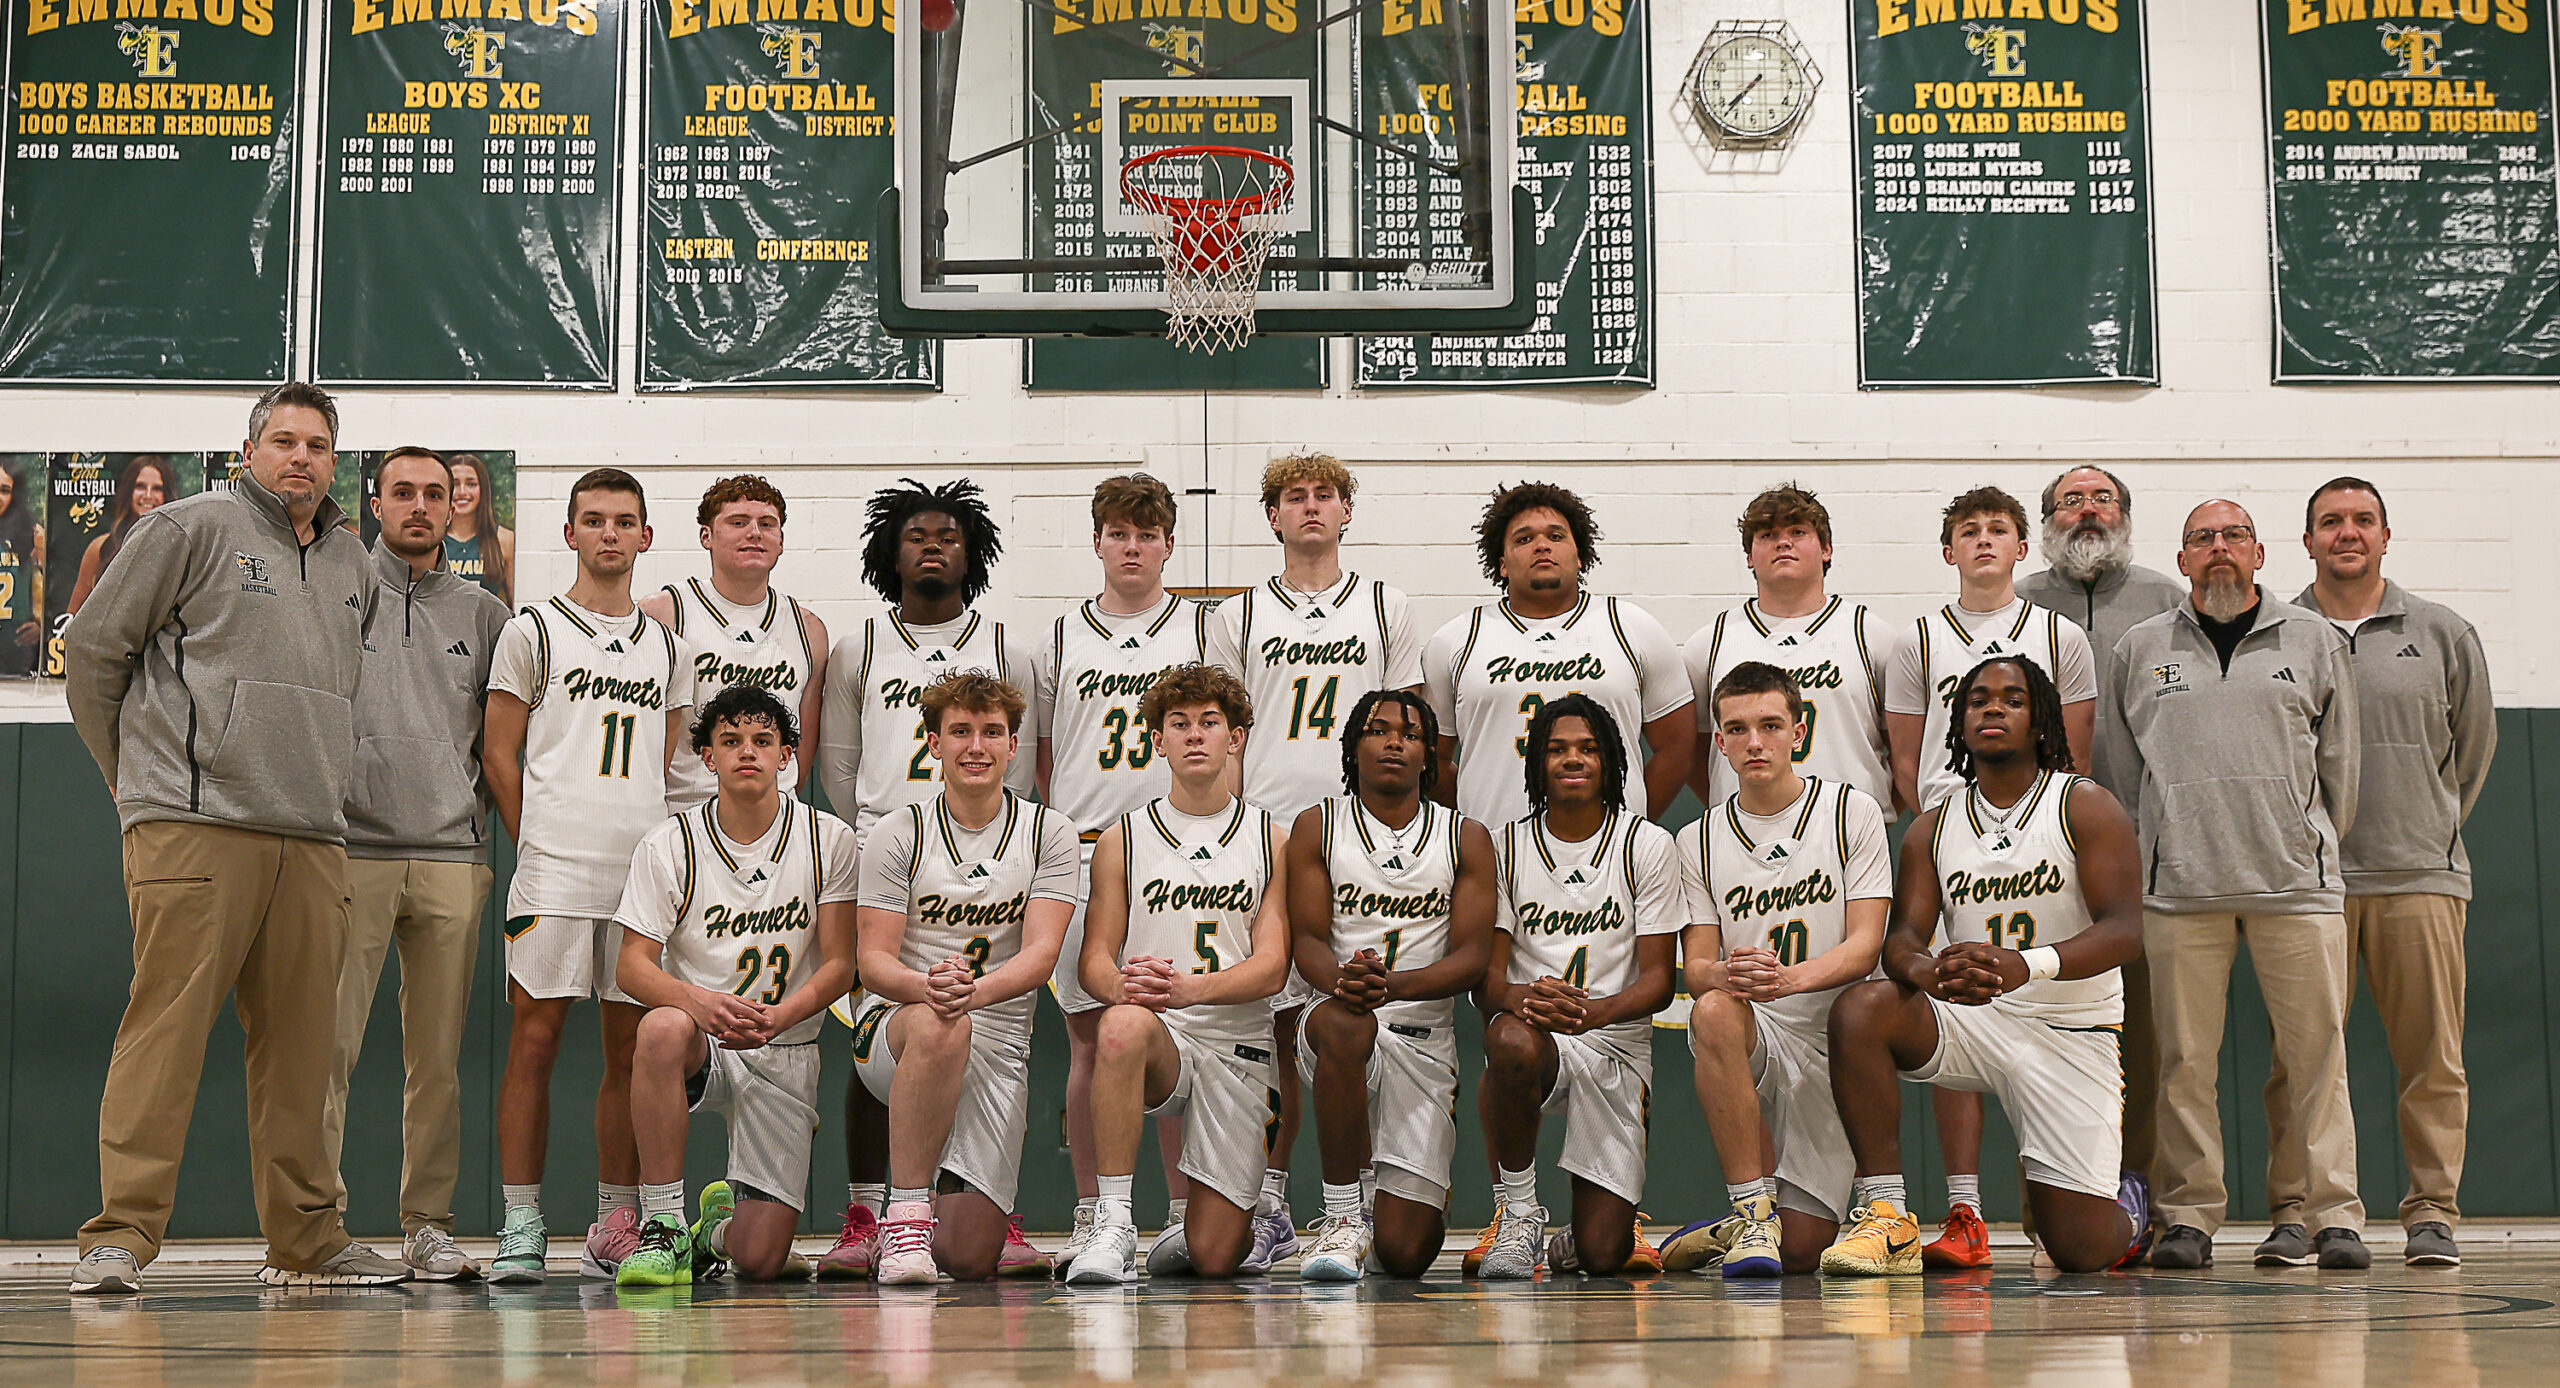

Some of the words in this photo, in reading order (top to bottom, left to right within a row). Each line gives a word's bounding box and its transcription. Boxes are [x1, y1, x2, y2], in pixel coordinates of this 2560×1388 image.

[19, 82, 88, 109] BOYS
[97, 83, 273, 110] BASKETBALL
[404, 82, 488, 108] BOYS
[499, 82, 541, 109] XC
[705, 84, 875, 111] FOOTBALL
[1914, 81, 2083, 109] FOOTBALL
[2326, 80, 2496, 107] FOOTBALL
[19, 114, 68, 135] 1000
[75, 115, 156, 135] CAREER
[163, 115, 272, 136] REBOUNDS
[366, 113, 431, 134] LEAGUE
[489, 114, 567, 135] DISTRICT
[572, 115, 589, 135] XI
[684, 116, 749, 136] LEAGUE
[805, 116, 884, 137] DISTRICT
[1128, 113, 1204, 133] POINT
[1213, 113, 1278, 133] CLUB
[1379, 113, 1440, 135] 1000
[1521, 115, 1627, 136] PASSING
[1875, 113, 1938, 134] 1000
[1945, 112, 2010, 133] YARD
[2017, 111, 2126, 133] RUSHING
[2284, 109, 2350, 131] 2000
[2357, 110, 2422, 131] YARD
[2429, 111, 2537, 132] RUSHING
[17, 144, 59, 159] 2019
[72, 144, 118, 160] ZACH
[124, 144, 180, 160] SABOL
[231, 145, 272, 160] 1046
[341, 138, 374, 153] 1979
[483, 139, 515, 154] 1976
[524, 139, 556, 154] 1979
[657, 146, 688, 161] 1962
[697, 146, 729, 161] 1963
[1054, 144, 1091, 160] 1941
[1588, 145, 1631, 160] 1532
[1873, 145, 1913, 160] 2017
[2087, 142, 2121, 156] 1111
[2285, 145, 2325, 160] 2014
[2333, 145, 2394, 160] ANDREW
[422, 158, 455, 173] 1999
[523, 159, 555, 174] 1994
[564, 159, 596, 174] 1997
[657, 165, 688, 181] 1972
[697, 165, 728, 180] 1981
[738, 165, 772, 180] 2016
[1054, 164, 1091, 179] 1971
[1376, 162, 1415, 177] 1991
[1588, 162, 1631, 177] 1495
[1874, 162, 1916, 177] 2018
[1985, 161, 2043, 176] MYERS
[2286, 165, 2326, 180] 2015
[2333, 165, 2372, 180] KYLE
[340, 177, 373, 192] 2000
[381, 177, 413, 192] 2001
[523, 178, 554, 193] 1999
[562, 179, 595, 193] 2000
[656, 184, 688, 199] 2018
[1054, 184, 1093, 198] 1972
[1376, 179, 1418, 194] 1992
[1588, 179, 1632, 194] 1802
[1874, 180, 1920, 195] 2019
[1925, 181, 2005, 195] BRANDON
[1054, 203, 1095, 219] 2003
[1376, 197, 1418, 211] 1993
[1875, 197, 1918, 212] 2024
[1926, 198, 1986, 212] REILLY
[1990, 198, 2070, 213] BECHTEL
[1376, 214, 1418, 228] 1997
[1588, 213, 1632, 228] 1474
[1054, 222, 1095, 238] 2006
[1376, 231, 1420, 245] 2004
[1590, 230, 1633, 245] 1189
[665, 238, 734, 259] EASTERN
[757, 240, 869, 261] CONFERENCE
[1055, 242, 1093, 256] 2015
[1106, 244, 1141, 258] KYLE
[1270, 245, 1296, 257] 250
[1590, 247, 1634, 262] 1055
[666, 269, 700, 284] 2010
[708, 269, 743, 284] 2015
[1428, 261, 1488, 275] SCHUTT
[1591, 264, 1634, 279] 1139
[1055, 278, 1093, 292] 2016
[1108, 278, 1159, 292] LUBANS
[1270, 280, 1297, 292] 102
[1591, 281, 1634, 296] 1189
[1591, 298, 1635, 313] 1288
[1592, 314, 1636, 329] 1826
[1431, 337, 1498, 350] ANDREW
[1504, 335, 1566, 348] KERSON
[1593, 332, 1638, 348] 1117
[1431, 351, 1483, 367] DEREK
[1487, 351, 1566, 367] SHEAFFER
[1594, 349, 1634, 364] 1228
[54, 479, 116, 495] VOLLEYBALL
[241, 583, 278, 597] BASKETBALL
[1261, 635, 1368, 669] Hornets
[694, 652, 799, 691] Hornets
[1486, 653, 1606, 684] Hornets
[564, 667, 663, 711] Hornets
[1287, 674, 1338, 741] 14
[599, 710, 637, 779] 11
[1098, 706, 1153, 771] 33
[1946, 859, 2065, 906] Hornets
[1143, 879, 1254, 914] Hornets
[1338, 883, 1449, 919] Hornets
[1725, 868, 1836, 921] Hornets
[704, 896, 811, 938] Hornets
[1518, 895, 1625, 936] Hornets
[1191, 921, 1220, 974] 5
[1383, 928, 1402, 971] 1
[1767, 918, 1809, 967] 10
[963, 934, 992, 980] 3
[733, 943, 792, 1006] 23
[1562, 944, 1590, 991] 4
